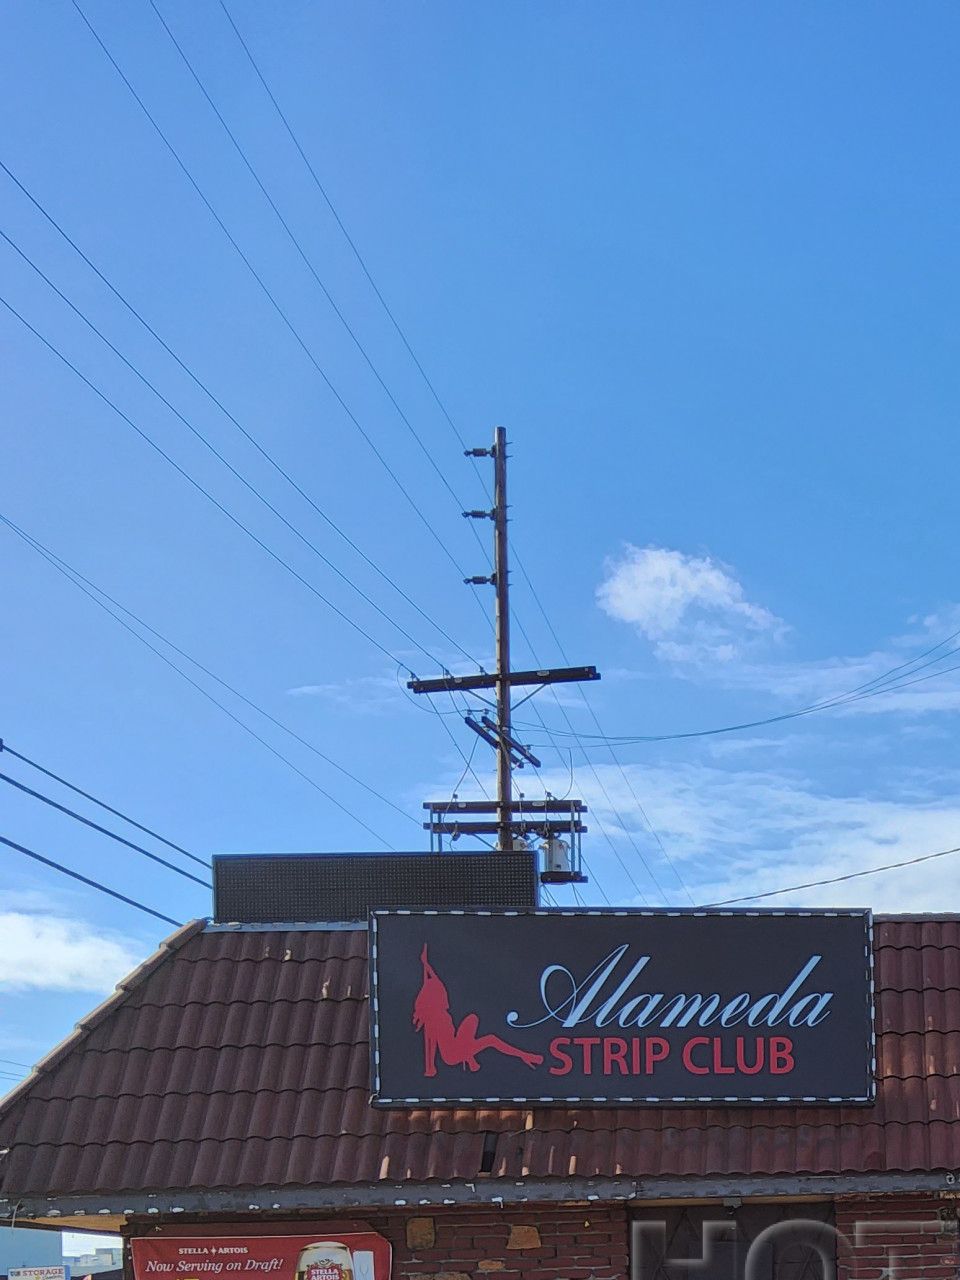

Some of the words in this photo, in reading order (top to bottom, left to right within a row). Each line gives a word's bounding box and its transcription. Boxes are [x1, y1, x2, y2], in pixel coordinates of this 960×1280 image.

[506, 943, 833, 1029] Alameda
[549, 1037, 670, 1075] STRIP
[682, 1037, 795, 1075] CLUB
[178, 1247, 209, 1255] STELLA
[218, 1246, 248, 1254] ARTOIS
[145, 1260, 174, 1272] Now
[176, 1259, 223, 1274] Serving
[226, 1261, 241, 1271] on
[244, 1258, 283, 1273] Draft!
